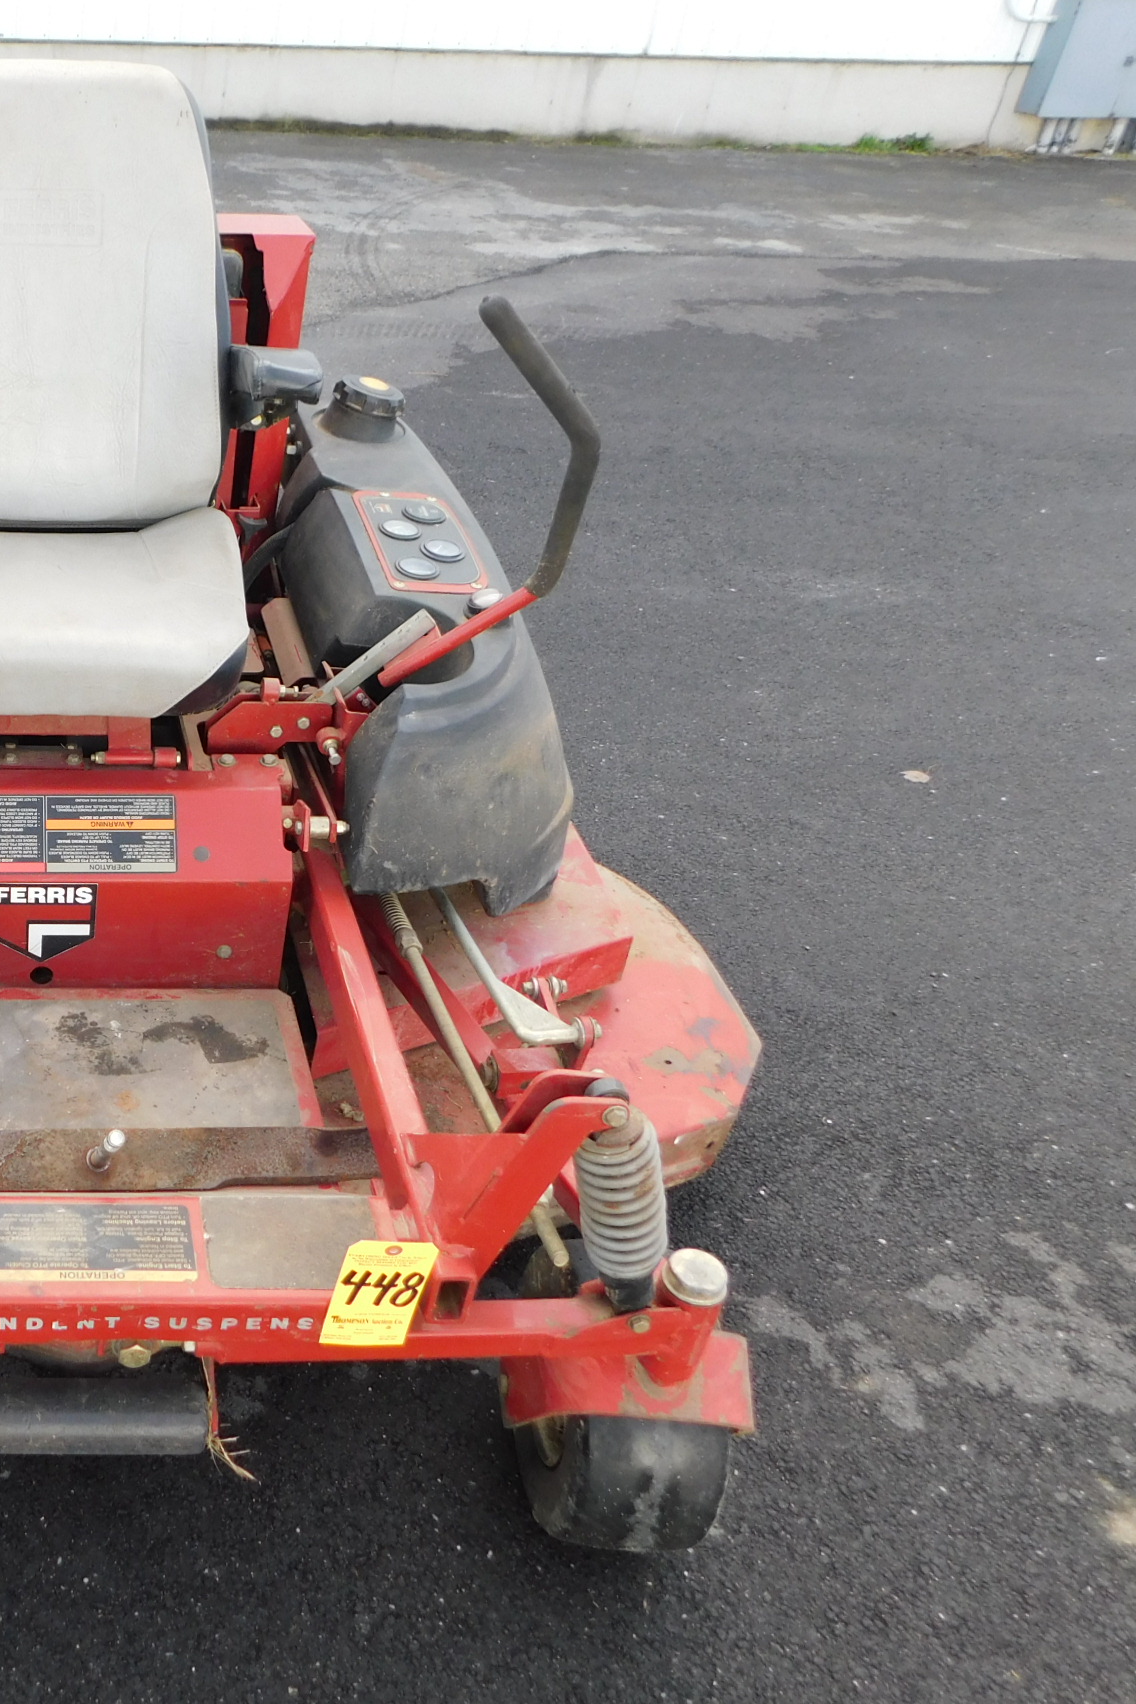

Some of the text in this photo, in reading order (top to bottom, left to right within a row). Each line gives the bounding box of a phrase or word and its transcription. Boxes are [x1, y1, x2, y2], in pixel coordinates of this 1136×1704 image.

[59, 1272, 126, 1280] OPERATION
[340, 1269, 426, 1308] 448
[144, 1316, 314, 1330] SUSPENS
